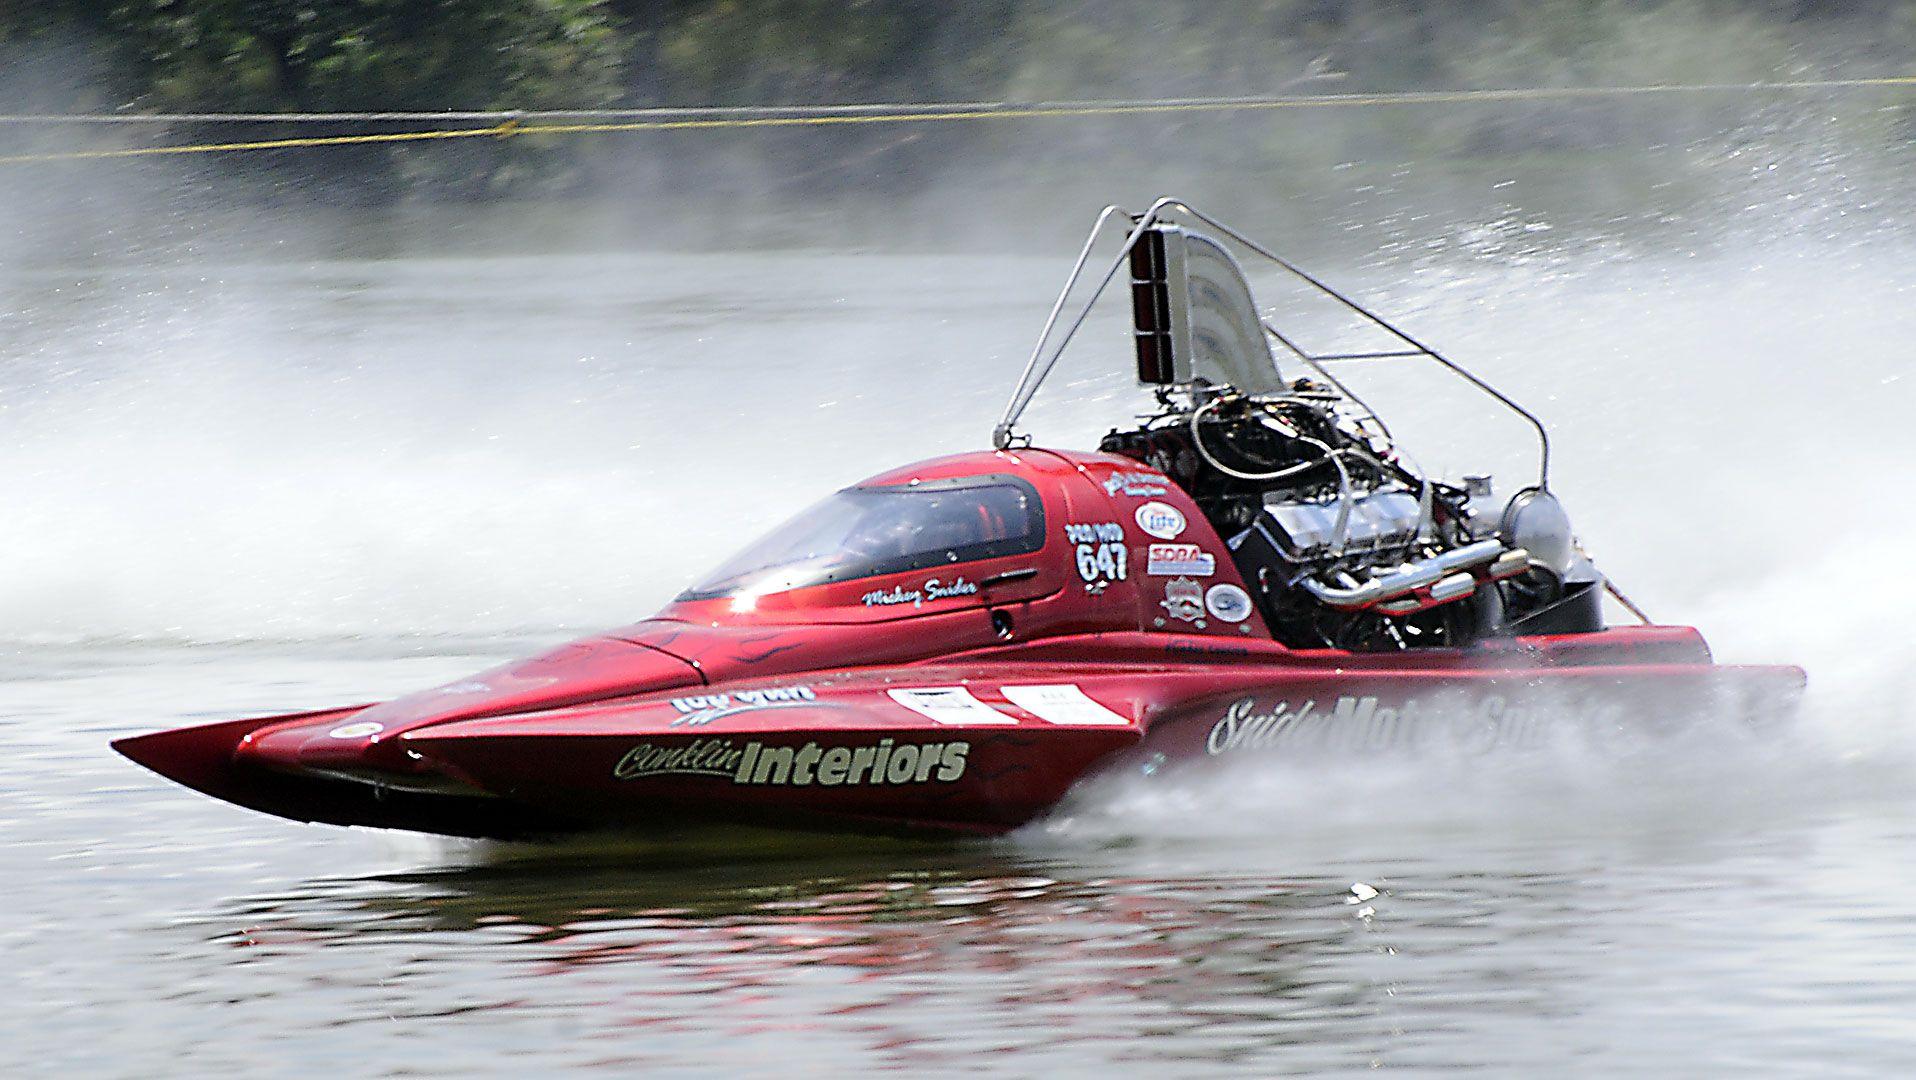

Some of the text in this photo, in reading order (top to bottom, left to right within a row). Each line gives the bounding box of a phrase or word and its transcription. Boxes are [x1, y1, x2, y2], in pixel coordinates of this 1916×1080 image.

[1076, 542, 1127, 581] 647
[861, 577, 977, 608] Mickey Snider
[733, 737, 971, 785] Interiors
